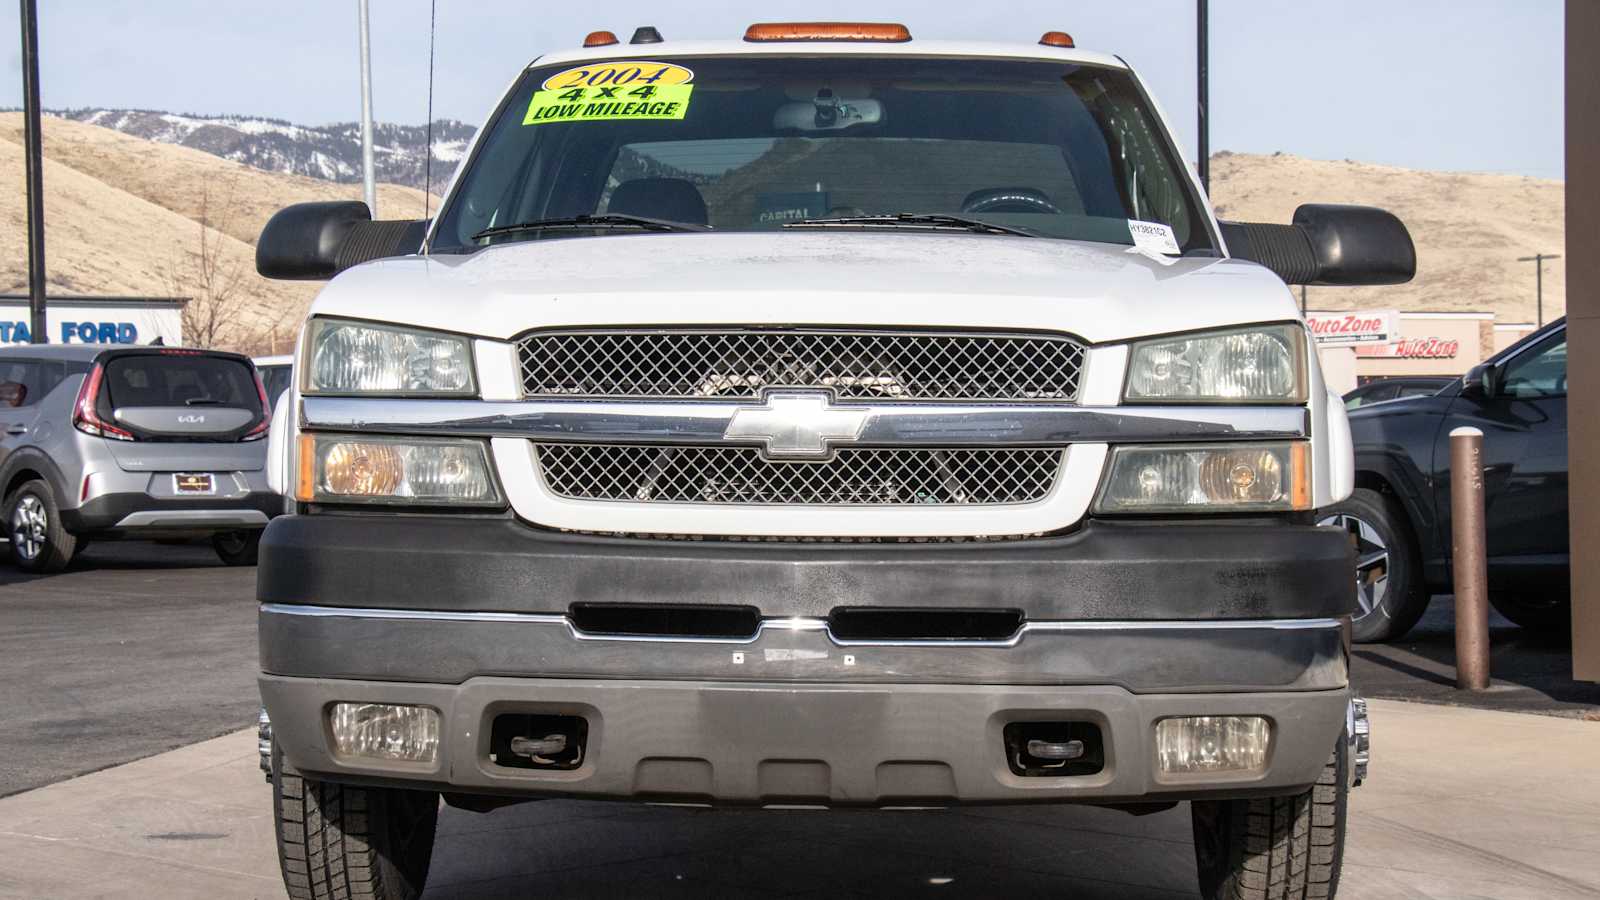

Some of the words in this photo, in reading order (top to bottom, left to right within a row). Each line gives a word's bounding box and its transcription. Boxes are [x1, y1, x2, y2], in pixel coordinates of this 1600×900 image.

[560, 66, 670, 88] 2004
[532, 104, 582, 120] LOW
[582, 102, 681, 117] MILEAGE
[61, 321, 138, 344] FORD
[1395, 338, 1459, 358] AutoZone
